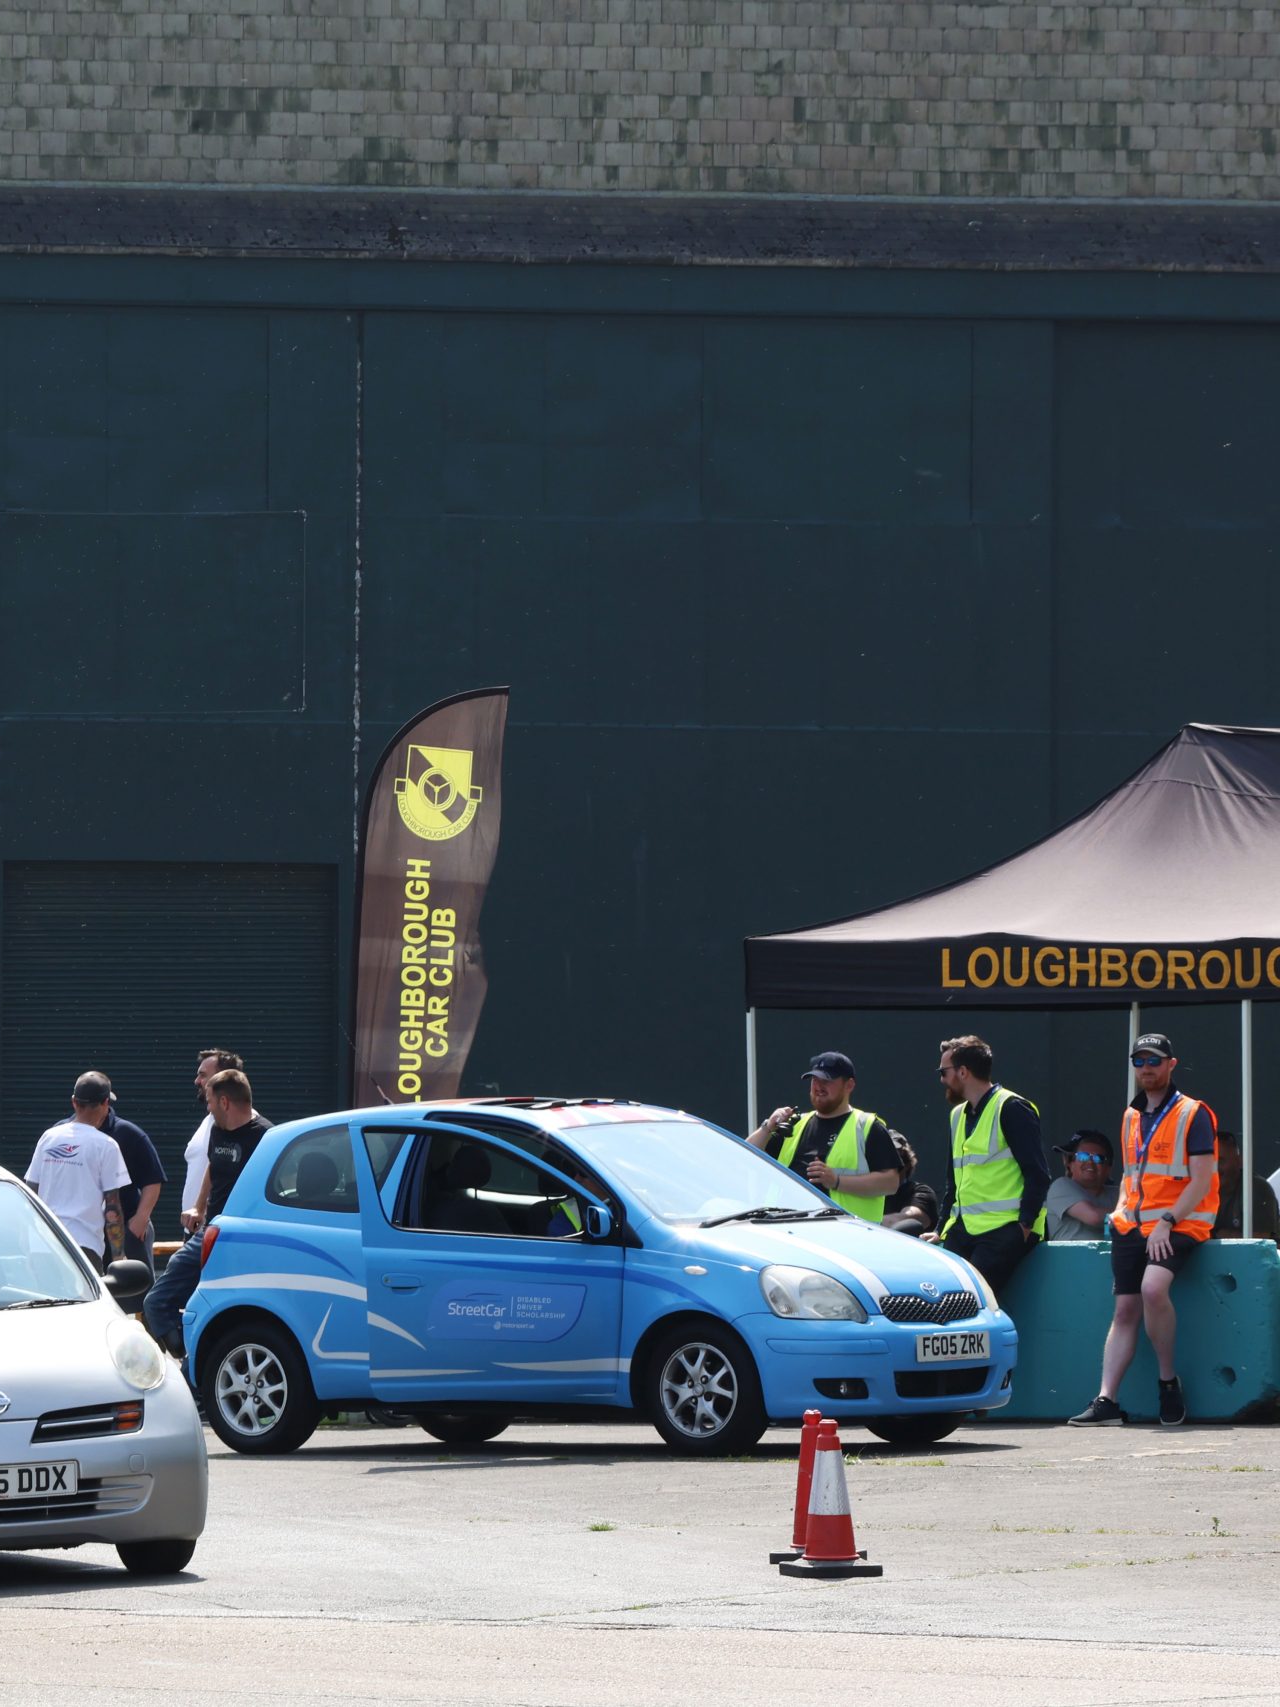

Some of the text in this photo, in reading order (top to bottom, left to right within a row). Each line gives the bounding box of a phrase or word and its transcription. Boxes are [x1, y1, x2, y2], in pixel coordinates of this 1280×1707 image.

[398, 858, 431, 1104] OUGHBOROUGH
[425, 908, 456, 1057] CAR CLUB
[448, 1303, 506, 1317] StreetCar
[517, 1296, 552, 1304] DISABLED
[516, 1311, 566, 1319] SCHOLARSHIP
[922, 1333, 985, 1357] FG05 ZRK
[17, 1465, 67, 1493] DDX
